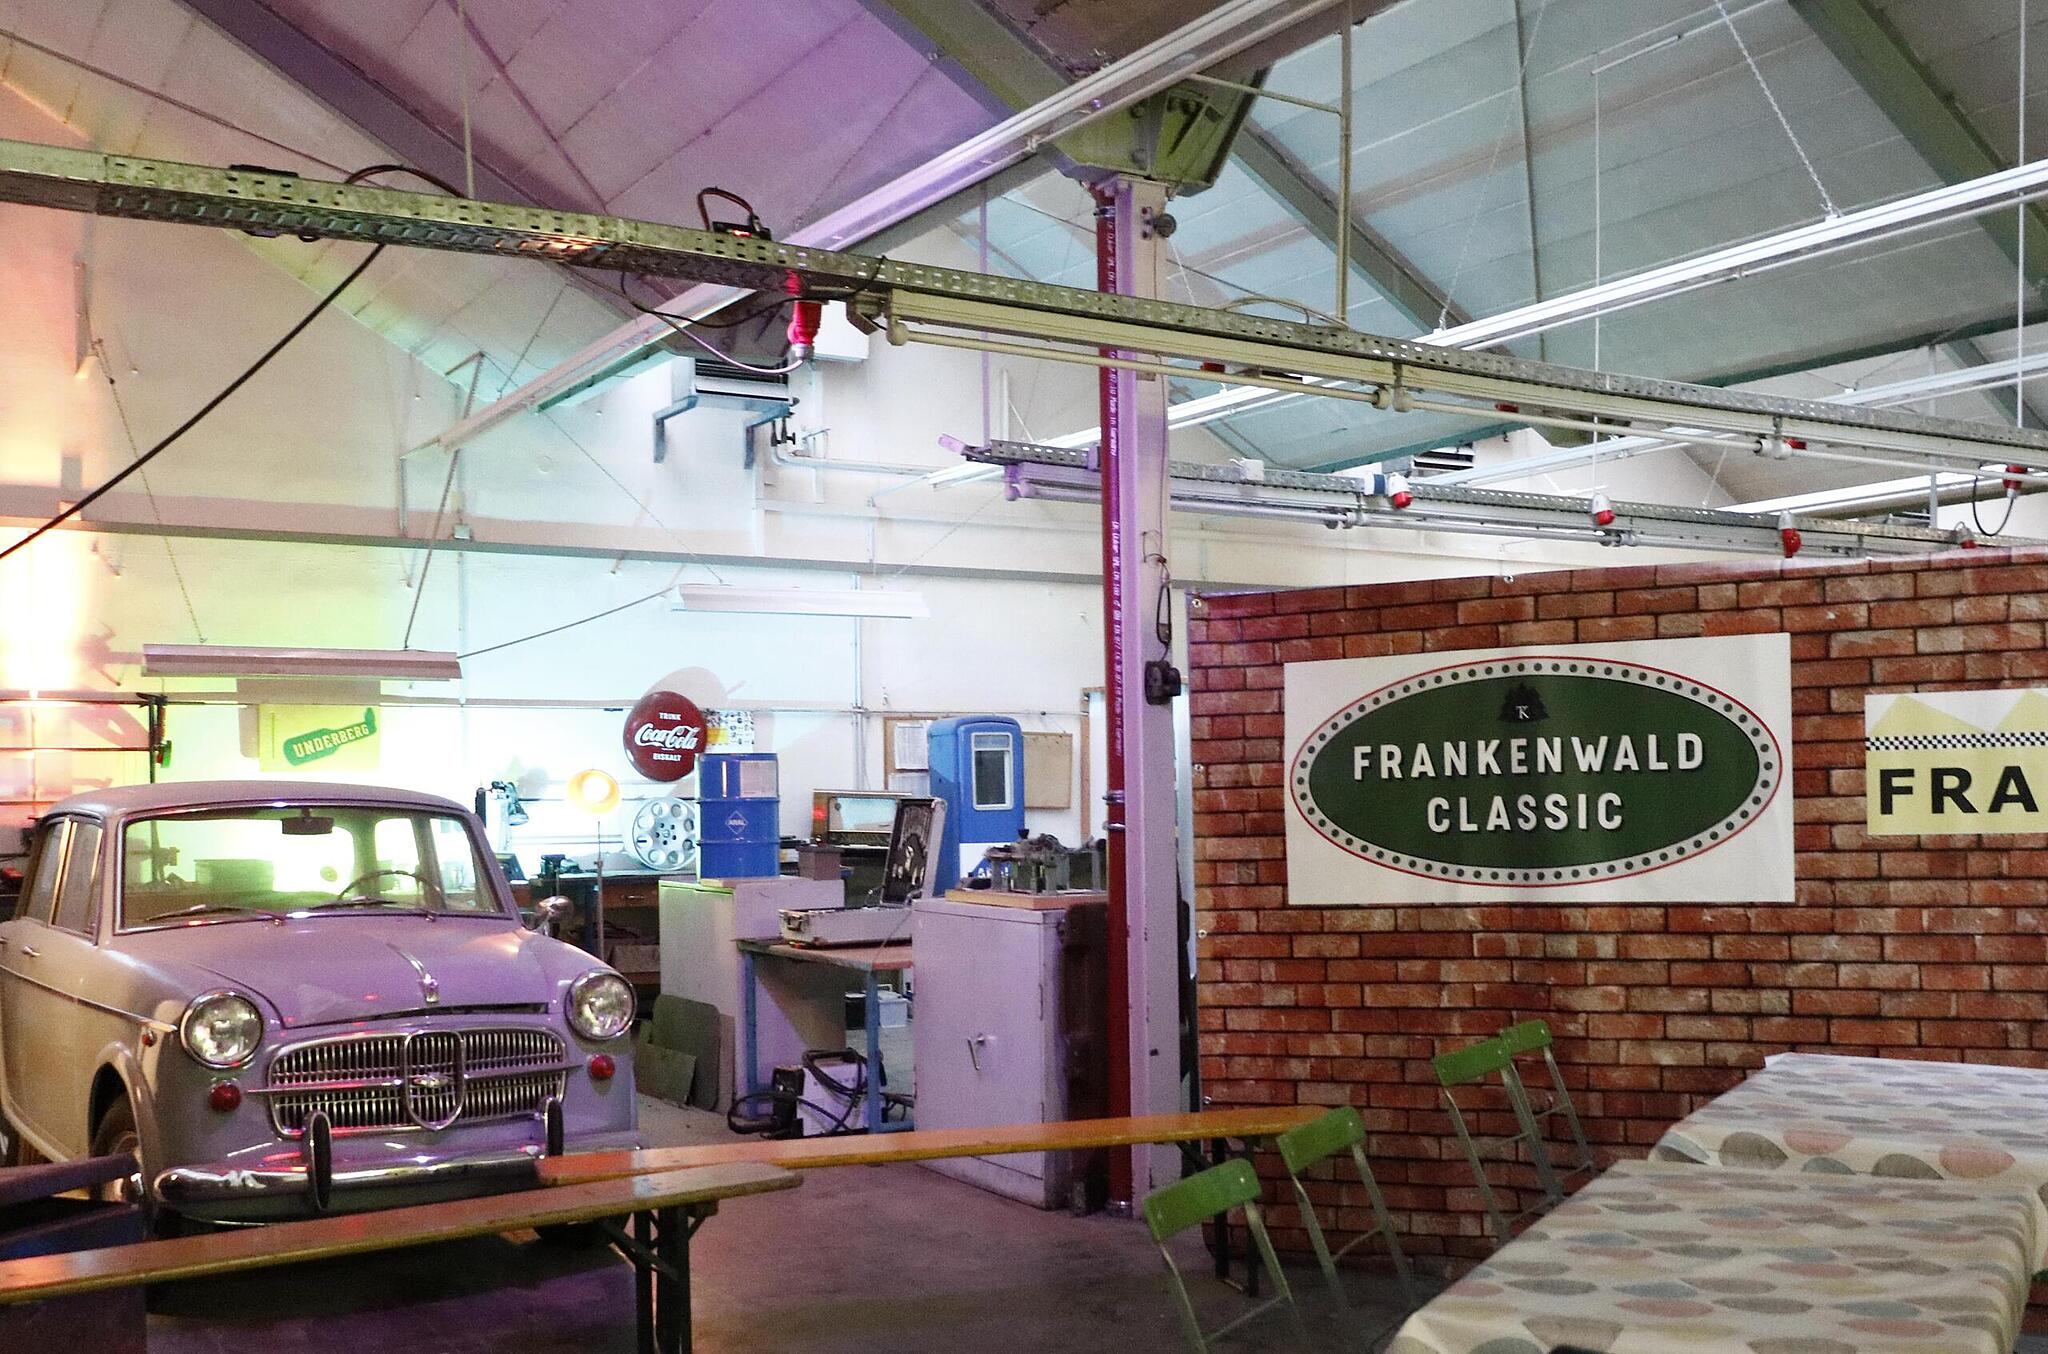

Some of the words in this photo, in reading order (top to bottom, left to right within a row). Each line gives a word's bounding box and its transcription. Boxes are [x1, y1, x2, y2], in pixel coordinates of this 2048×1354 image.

[292, 724, 369, 758] UNDERBERG
[1353, 733, 1704, 780] FRANKENWALD
[1880, 765, 2039, 815] FRA
[1427, 792, 1623, 834] CLASSIC
